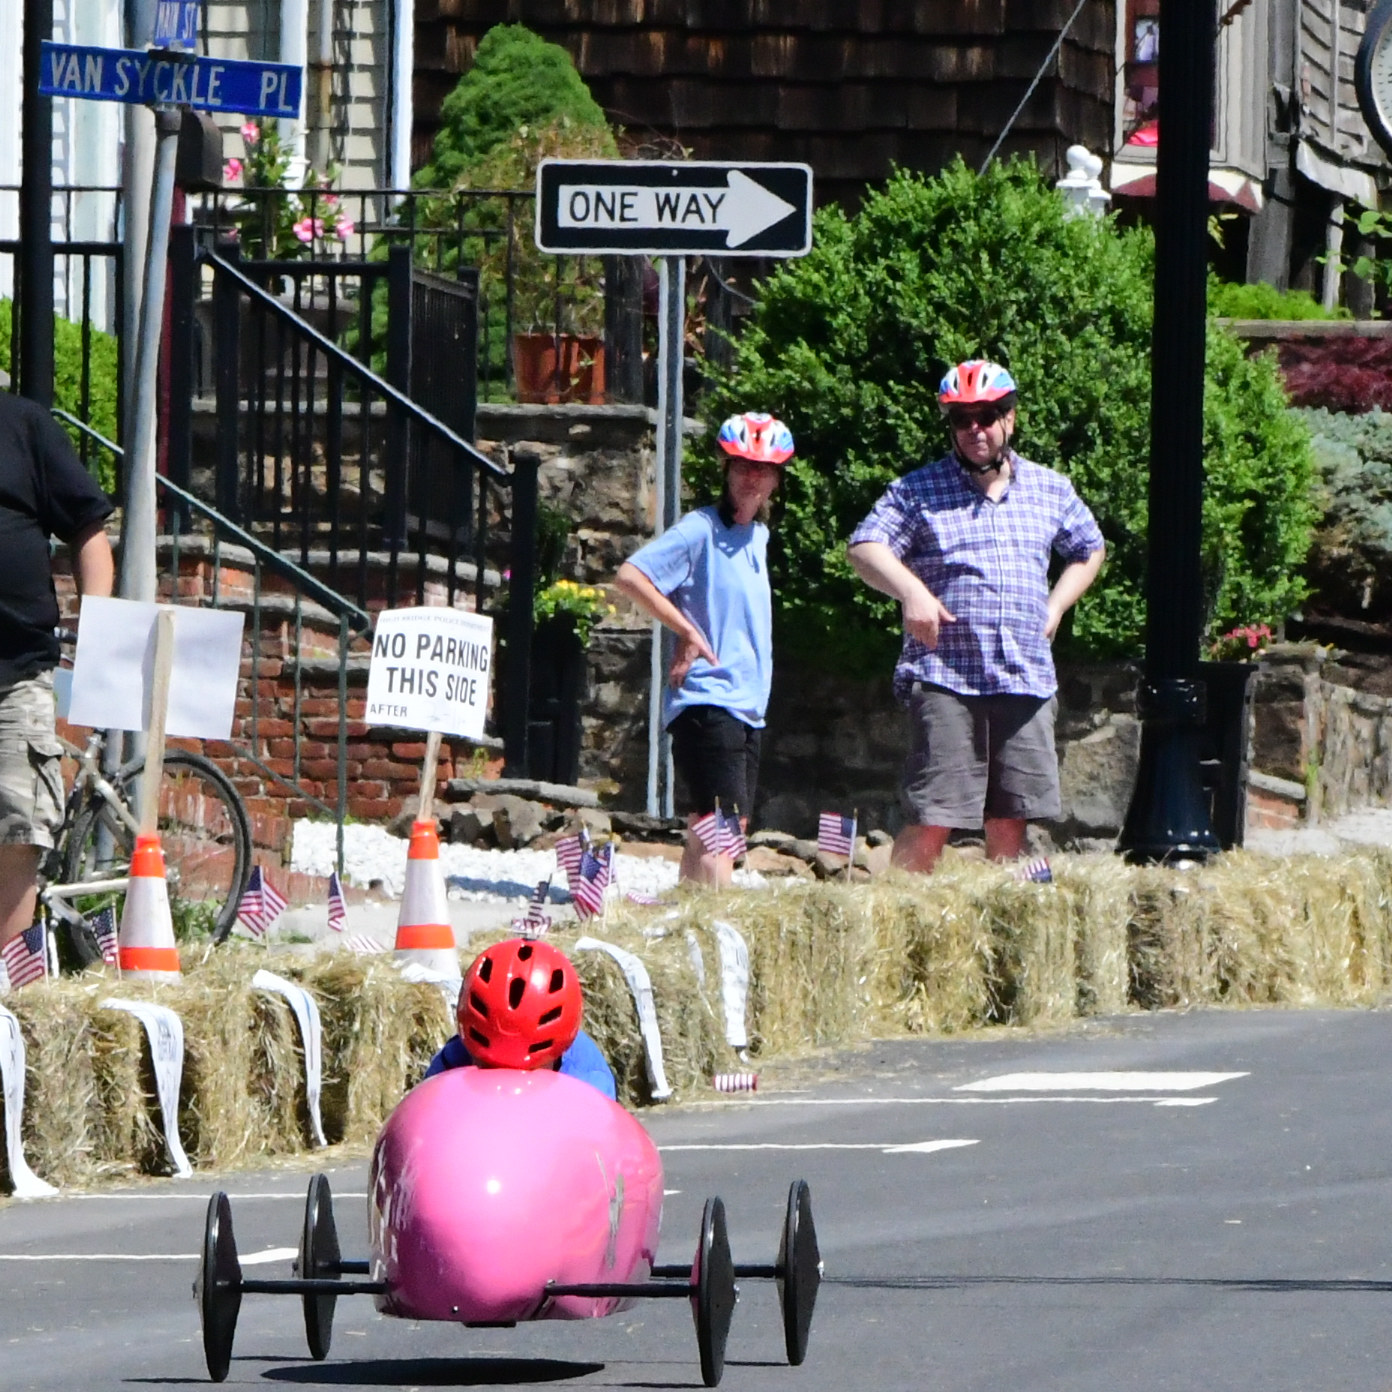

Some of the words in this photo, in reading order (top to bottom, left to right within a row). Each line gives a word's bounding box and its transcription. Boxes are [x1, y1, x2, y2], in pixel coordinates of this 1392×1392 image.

[51, 51, 103, 93] VAN
[114, 56, 225, 105] SYCKLE
[259, 70, 293, 111] PL
[569, 190, 639, 222] ONE
[655, 192, 726, 224] WAY
[374, 632, 407, 658] NO
[416, 633, 488, 673] PARKING
[386, 666, 439, 698] THIS
[445, 673, 477, 707] SIDE
[370, 703, 407, 717] AFTER
